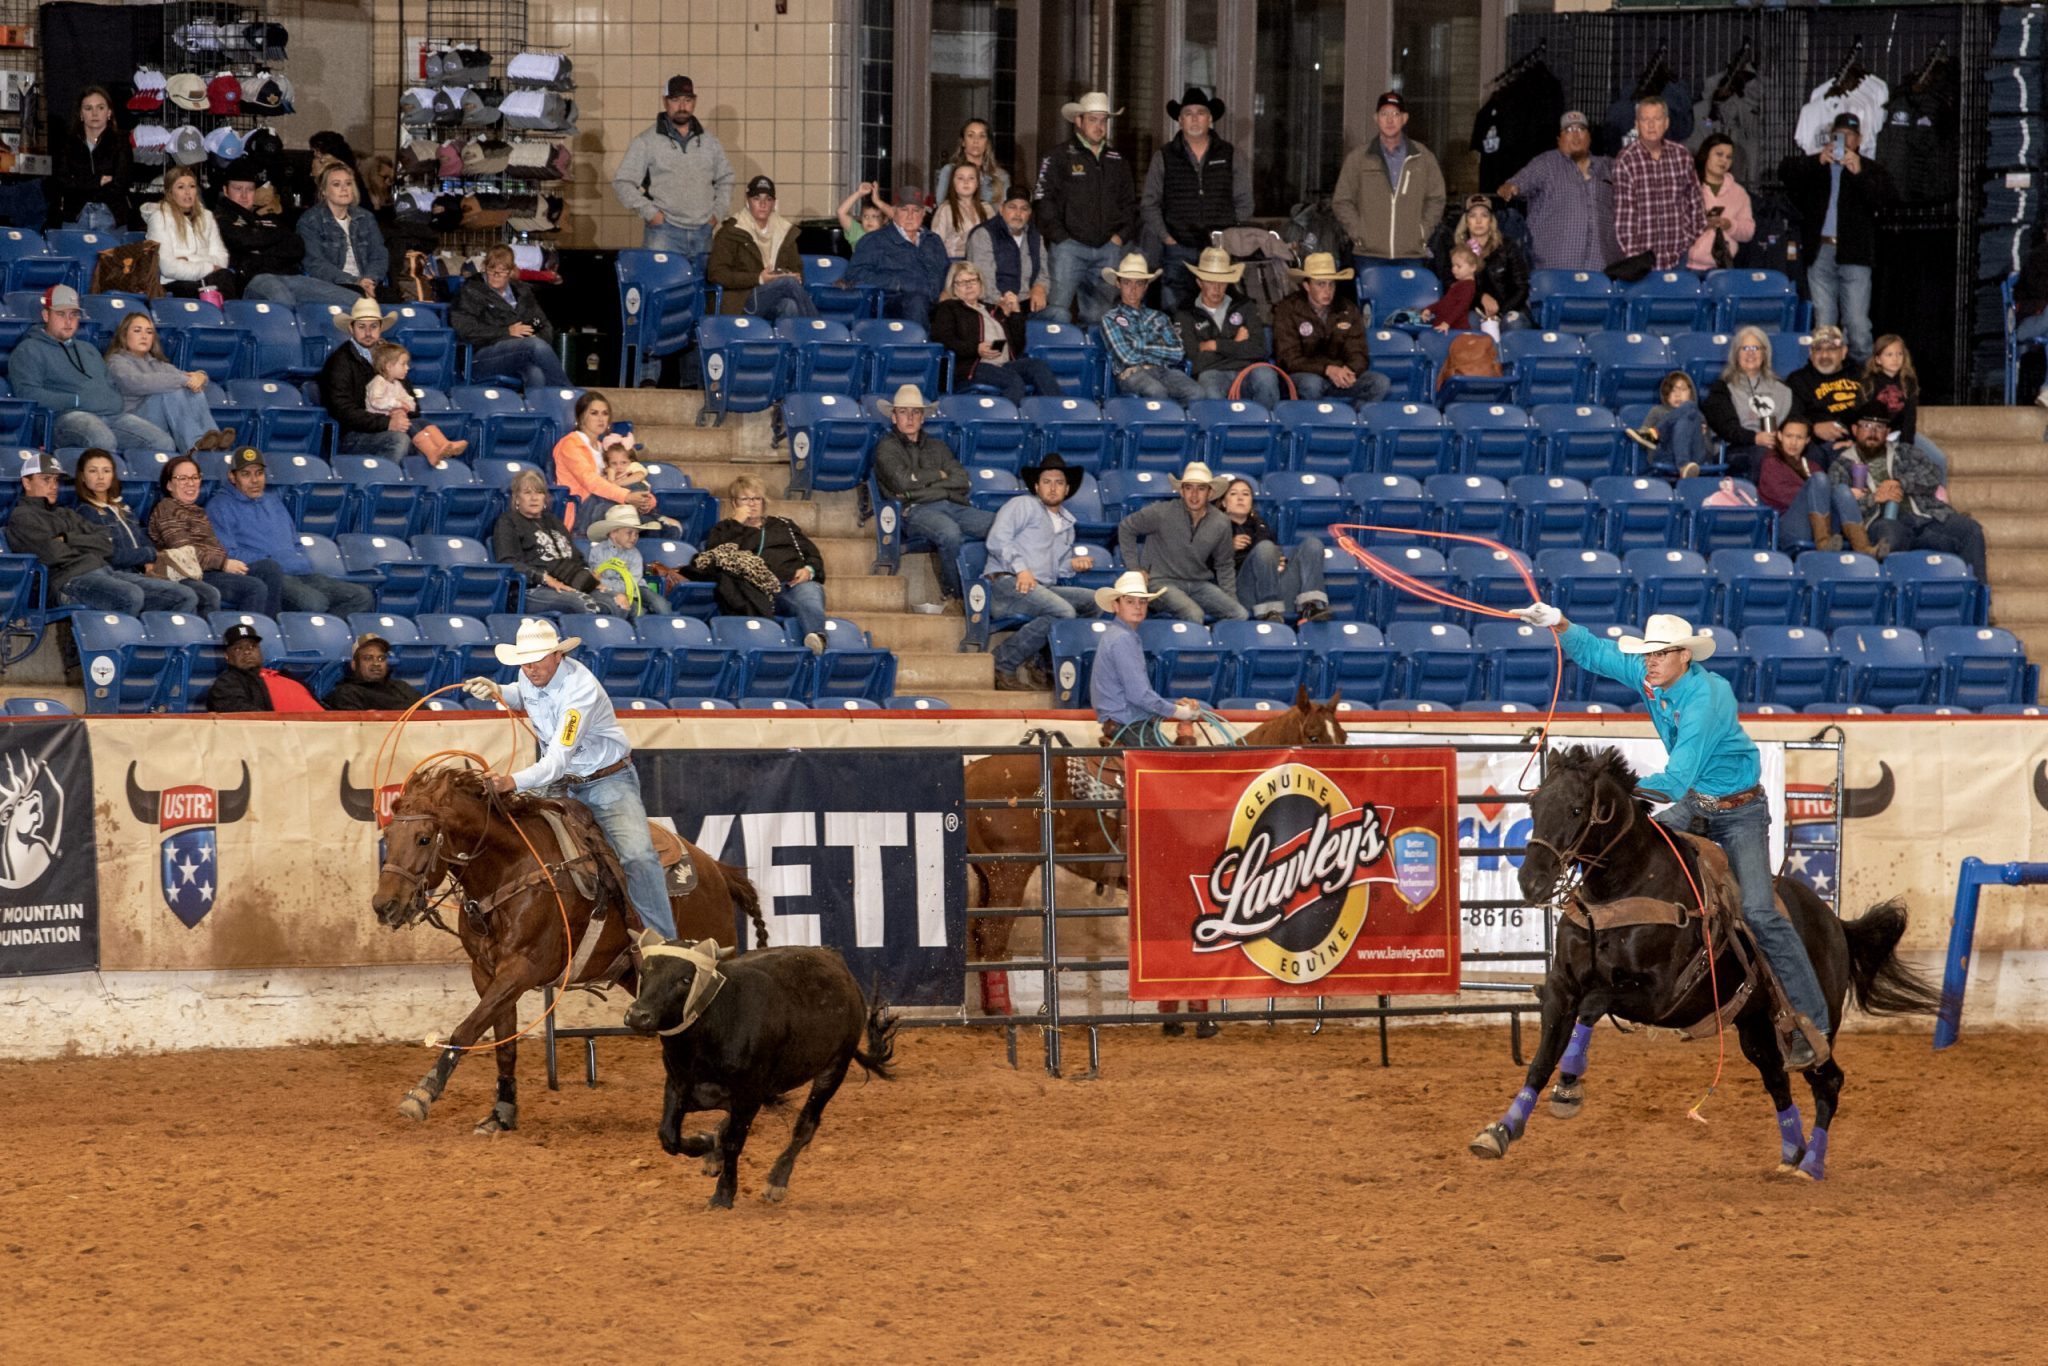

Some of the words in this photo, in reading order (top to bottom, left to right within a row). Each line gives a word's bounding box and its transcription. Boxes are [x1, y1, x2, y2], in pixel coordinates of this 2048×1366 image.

[164, 793, 212, 819] USTRC
[1245, 774, 1329, 820] GENUINE
[1195, 808, 1385, 942] Lawley's
[3, 904, 84, 923] MOUNTAIN
[1462, 909, 1523, 927] -8616
[0, 926, 80, 946] UNDATION
[1279, 927, 1349, 977] EQUINE
[1357, 946, 1445, 962] www.lawleys.com
